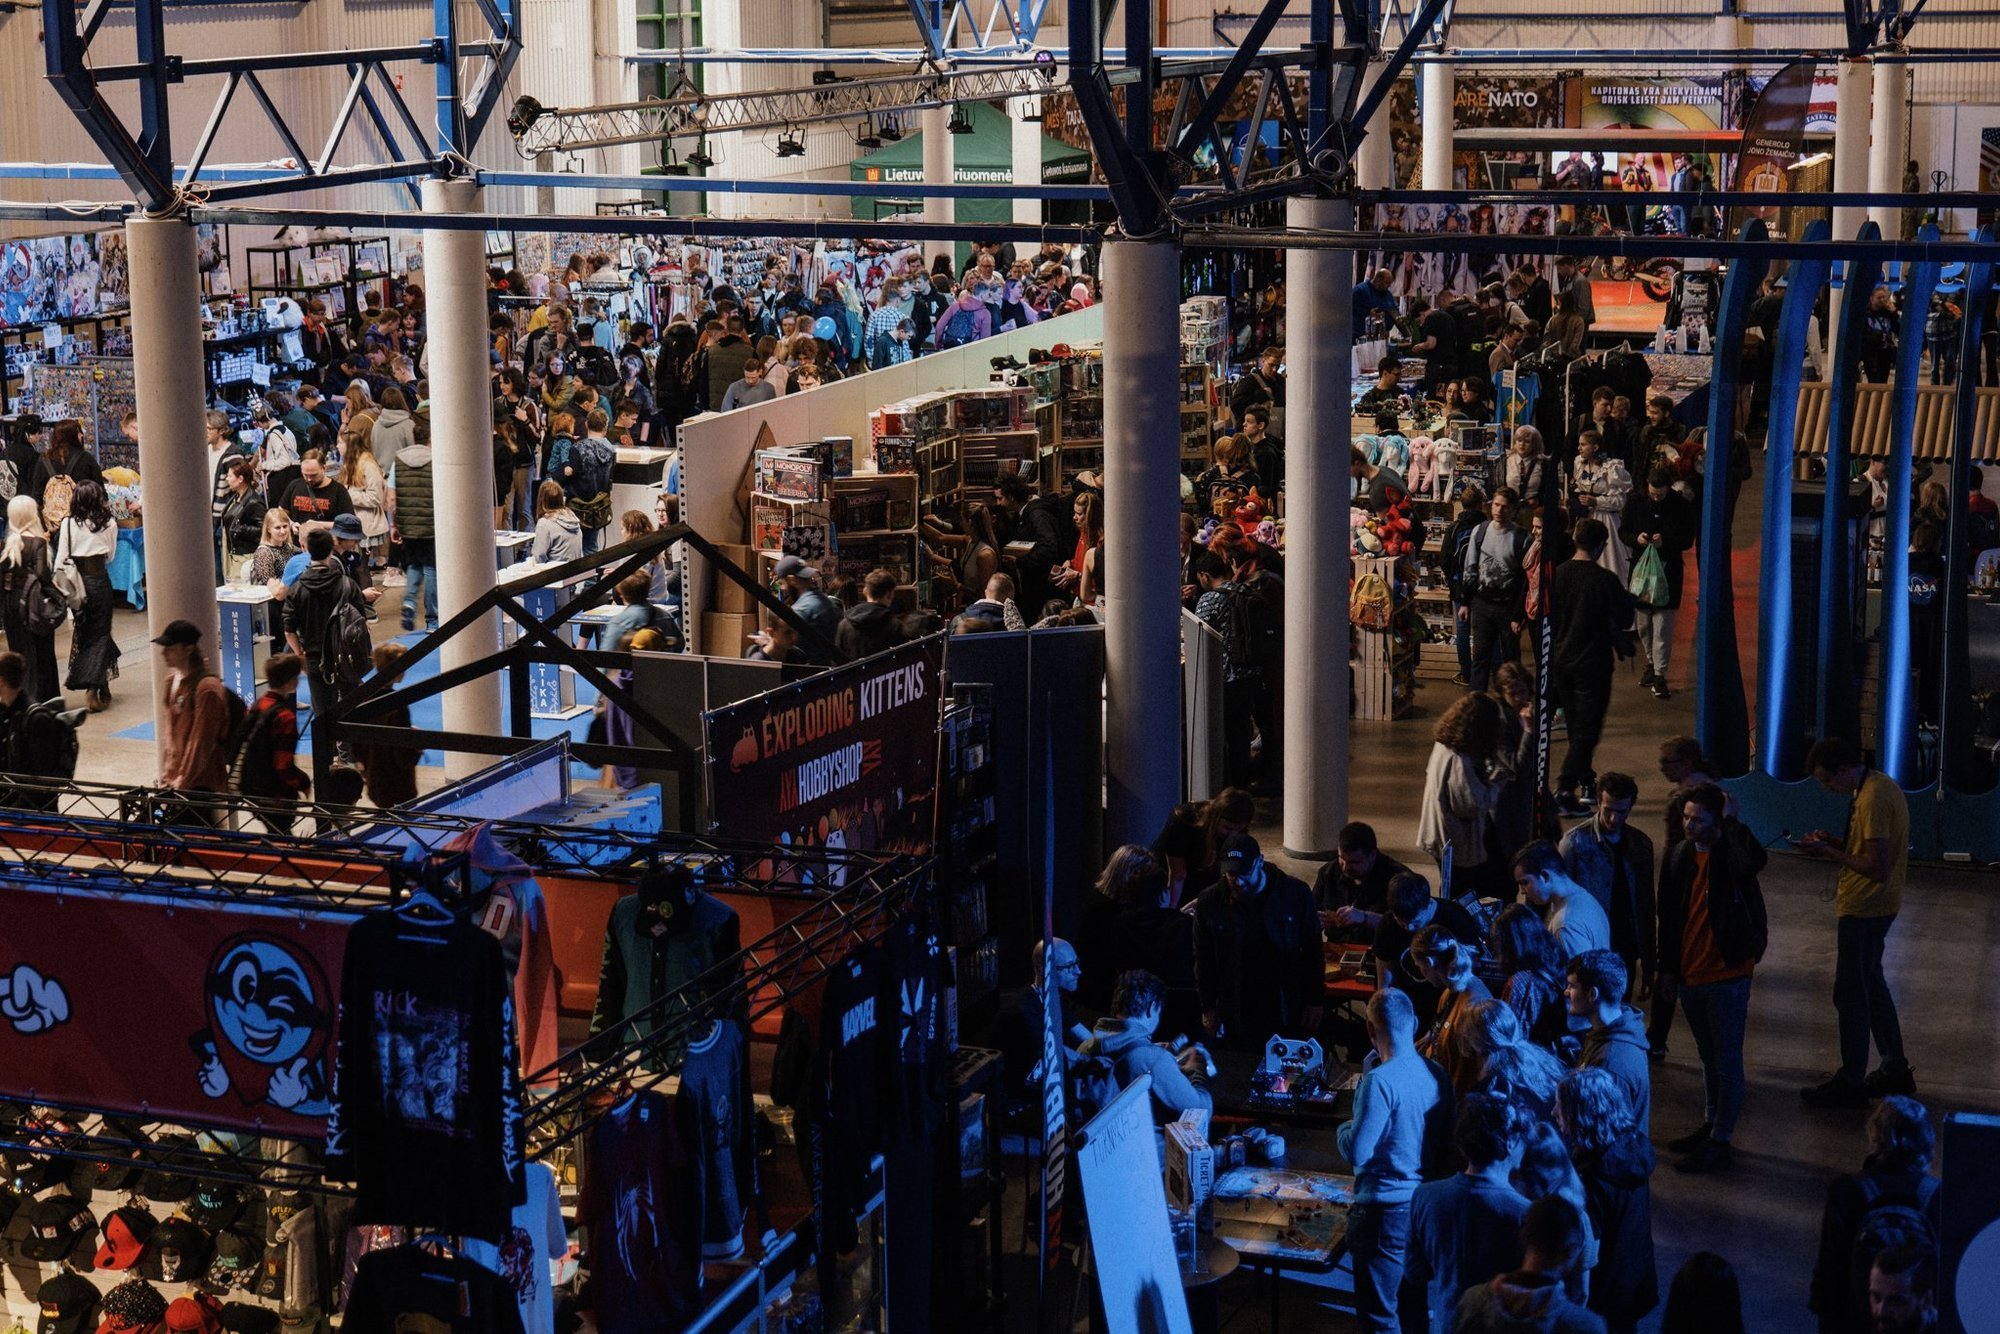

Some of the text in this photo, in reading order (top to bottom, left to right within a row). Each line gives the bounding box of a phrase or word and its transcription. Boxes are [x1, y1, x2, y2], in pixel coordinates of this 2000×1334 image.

[1591, 86, 1723, 96] KAPITONAS YRA KIEKVIENAME
[1454, 91, 1538, 108] ARENATO
[1631, 95, 1658, 105] LEISTI
[1660, 95, 1680, 105] JAM
[1806, 112, 1828, 123] TATES
[1755, 138, 1791, 150] GENEROLO
[1747, 146, 1796, 159] JONO ŽEMAIČIO
[885, 168, 1012, 182] Lietuv riuomenė
[776, 461, 811, 474] MONOPOLY
[1908, 584, 1937, 593] NASA
[231, 610, 240, 649] MENAS
[535, 597, 548, 708] INTIKA
[234, 653, 241, 668] IR
[761, 660, 926, 759] EXPLODING KITTENS
[798, 740, 864, 806] HOBBYSHOP
[373, 989, 419, 1017] RICK
[842, 995, 877, 1048] MARVEL
[1200, 1154, 1211, 1187] TICKET
